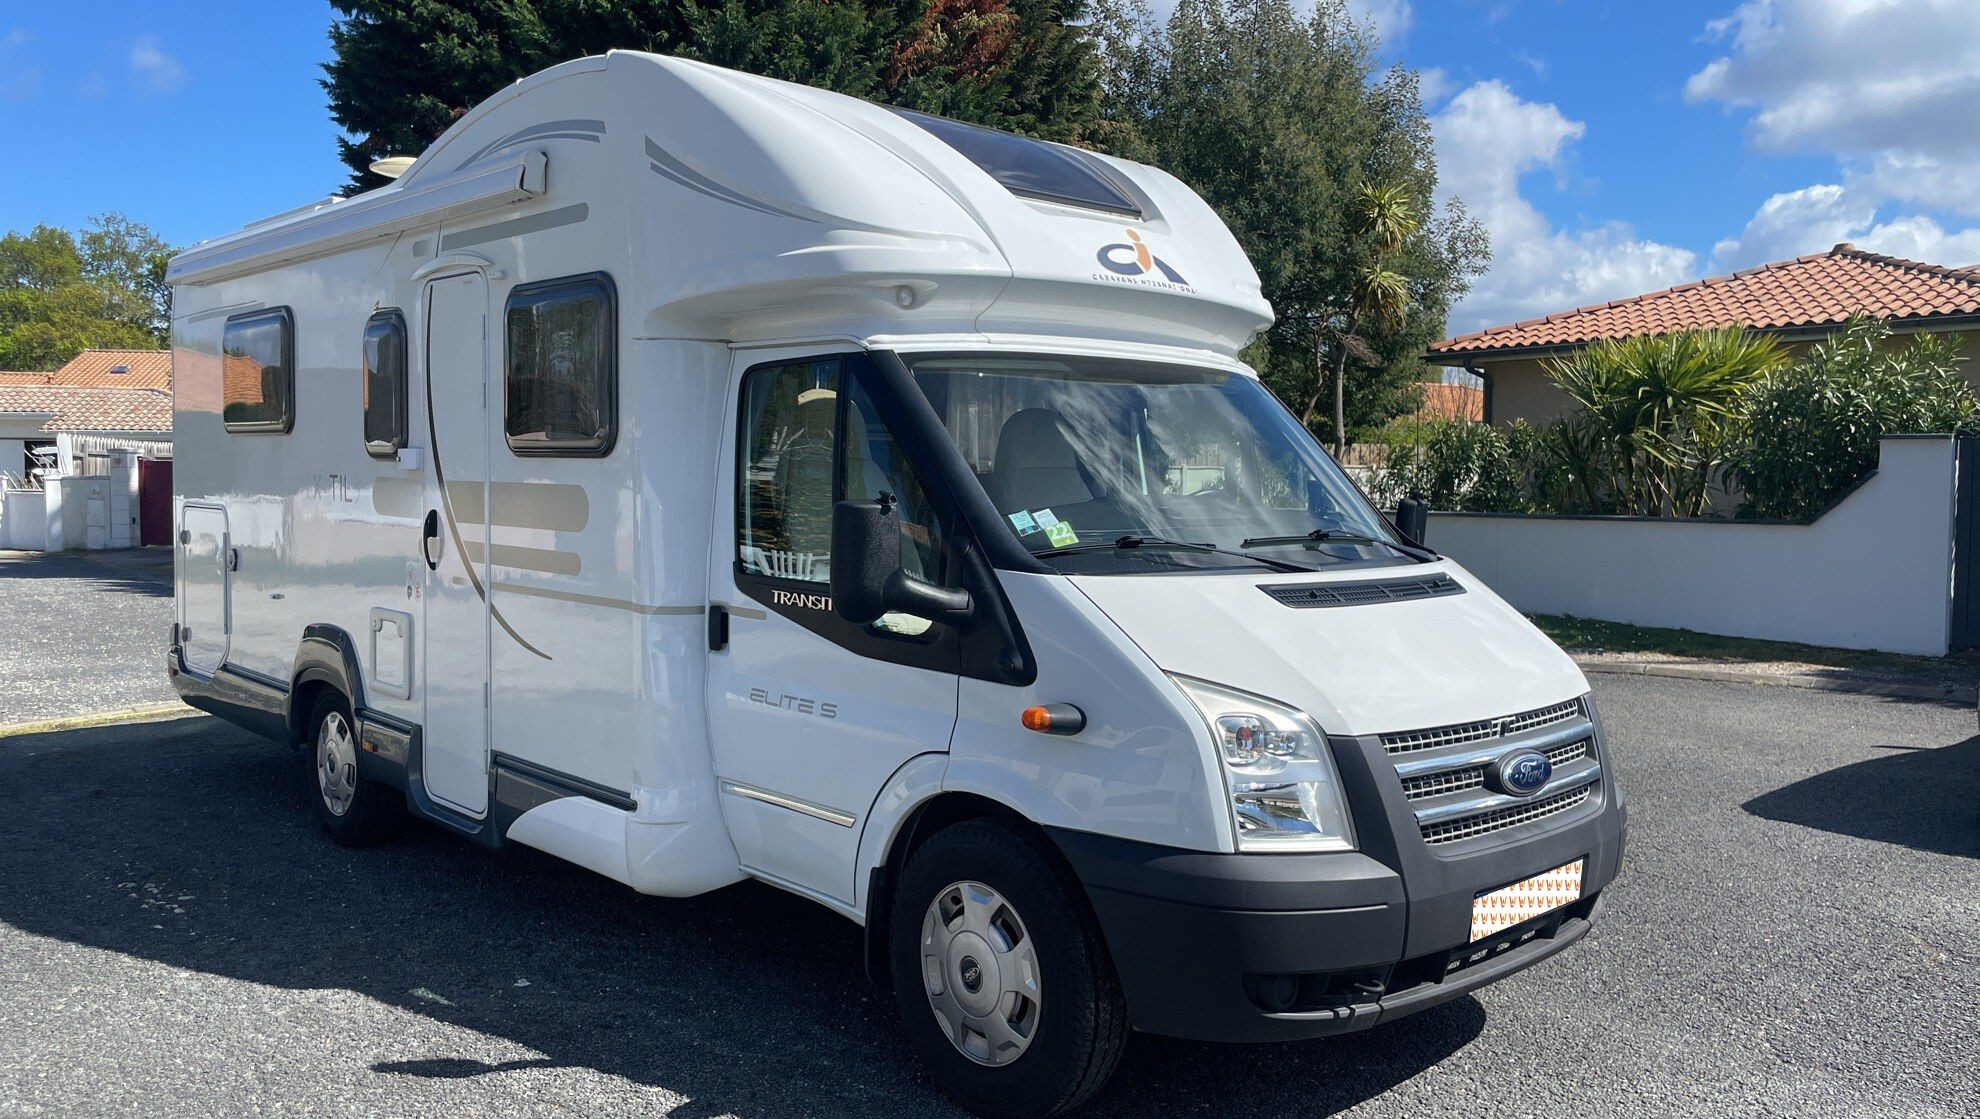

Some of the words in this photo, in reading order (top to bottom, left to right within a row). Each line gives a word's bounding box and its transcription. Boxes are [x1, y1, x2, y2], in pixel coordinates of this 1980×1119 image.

[1092, 273, 1138, 284] CARAVANS
[1139, 279, 1198, 294] NTERNATONA
[1045, 523, 1072, 540] 22
[771, 589, 832, 611] TRANSIT
[749, 687, 815, 715] ELITE
[820, 702, 838, 719] S
[1515, 761, 1545, 784] Ford
